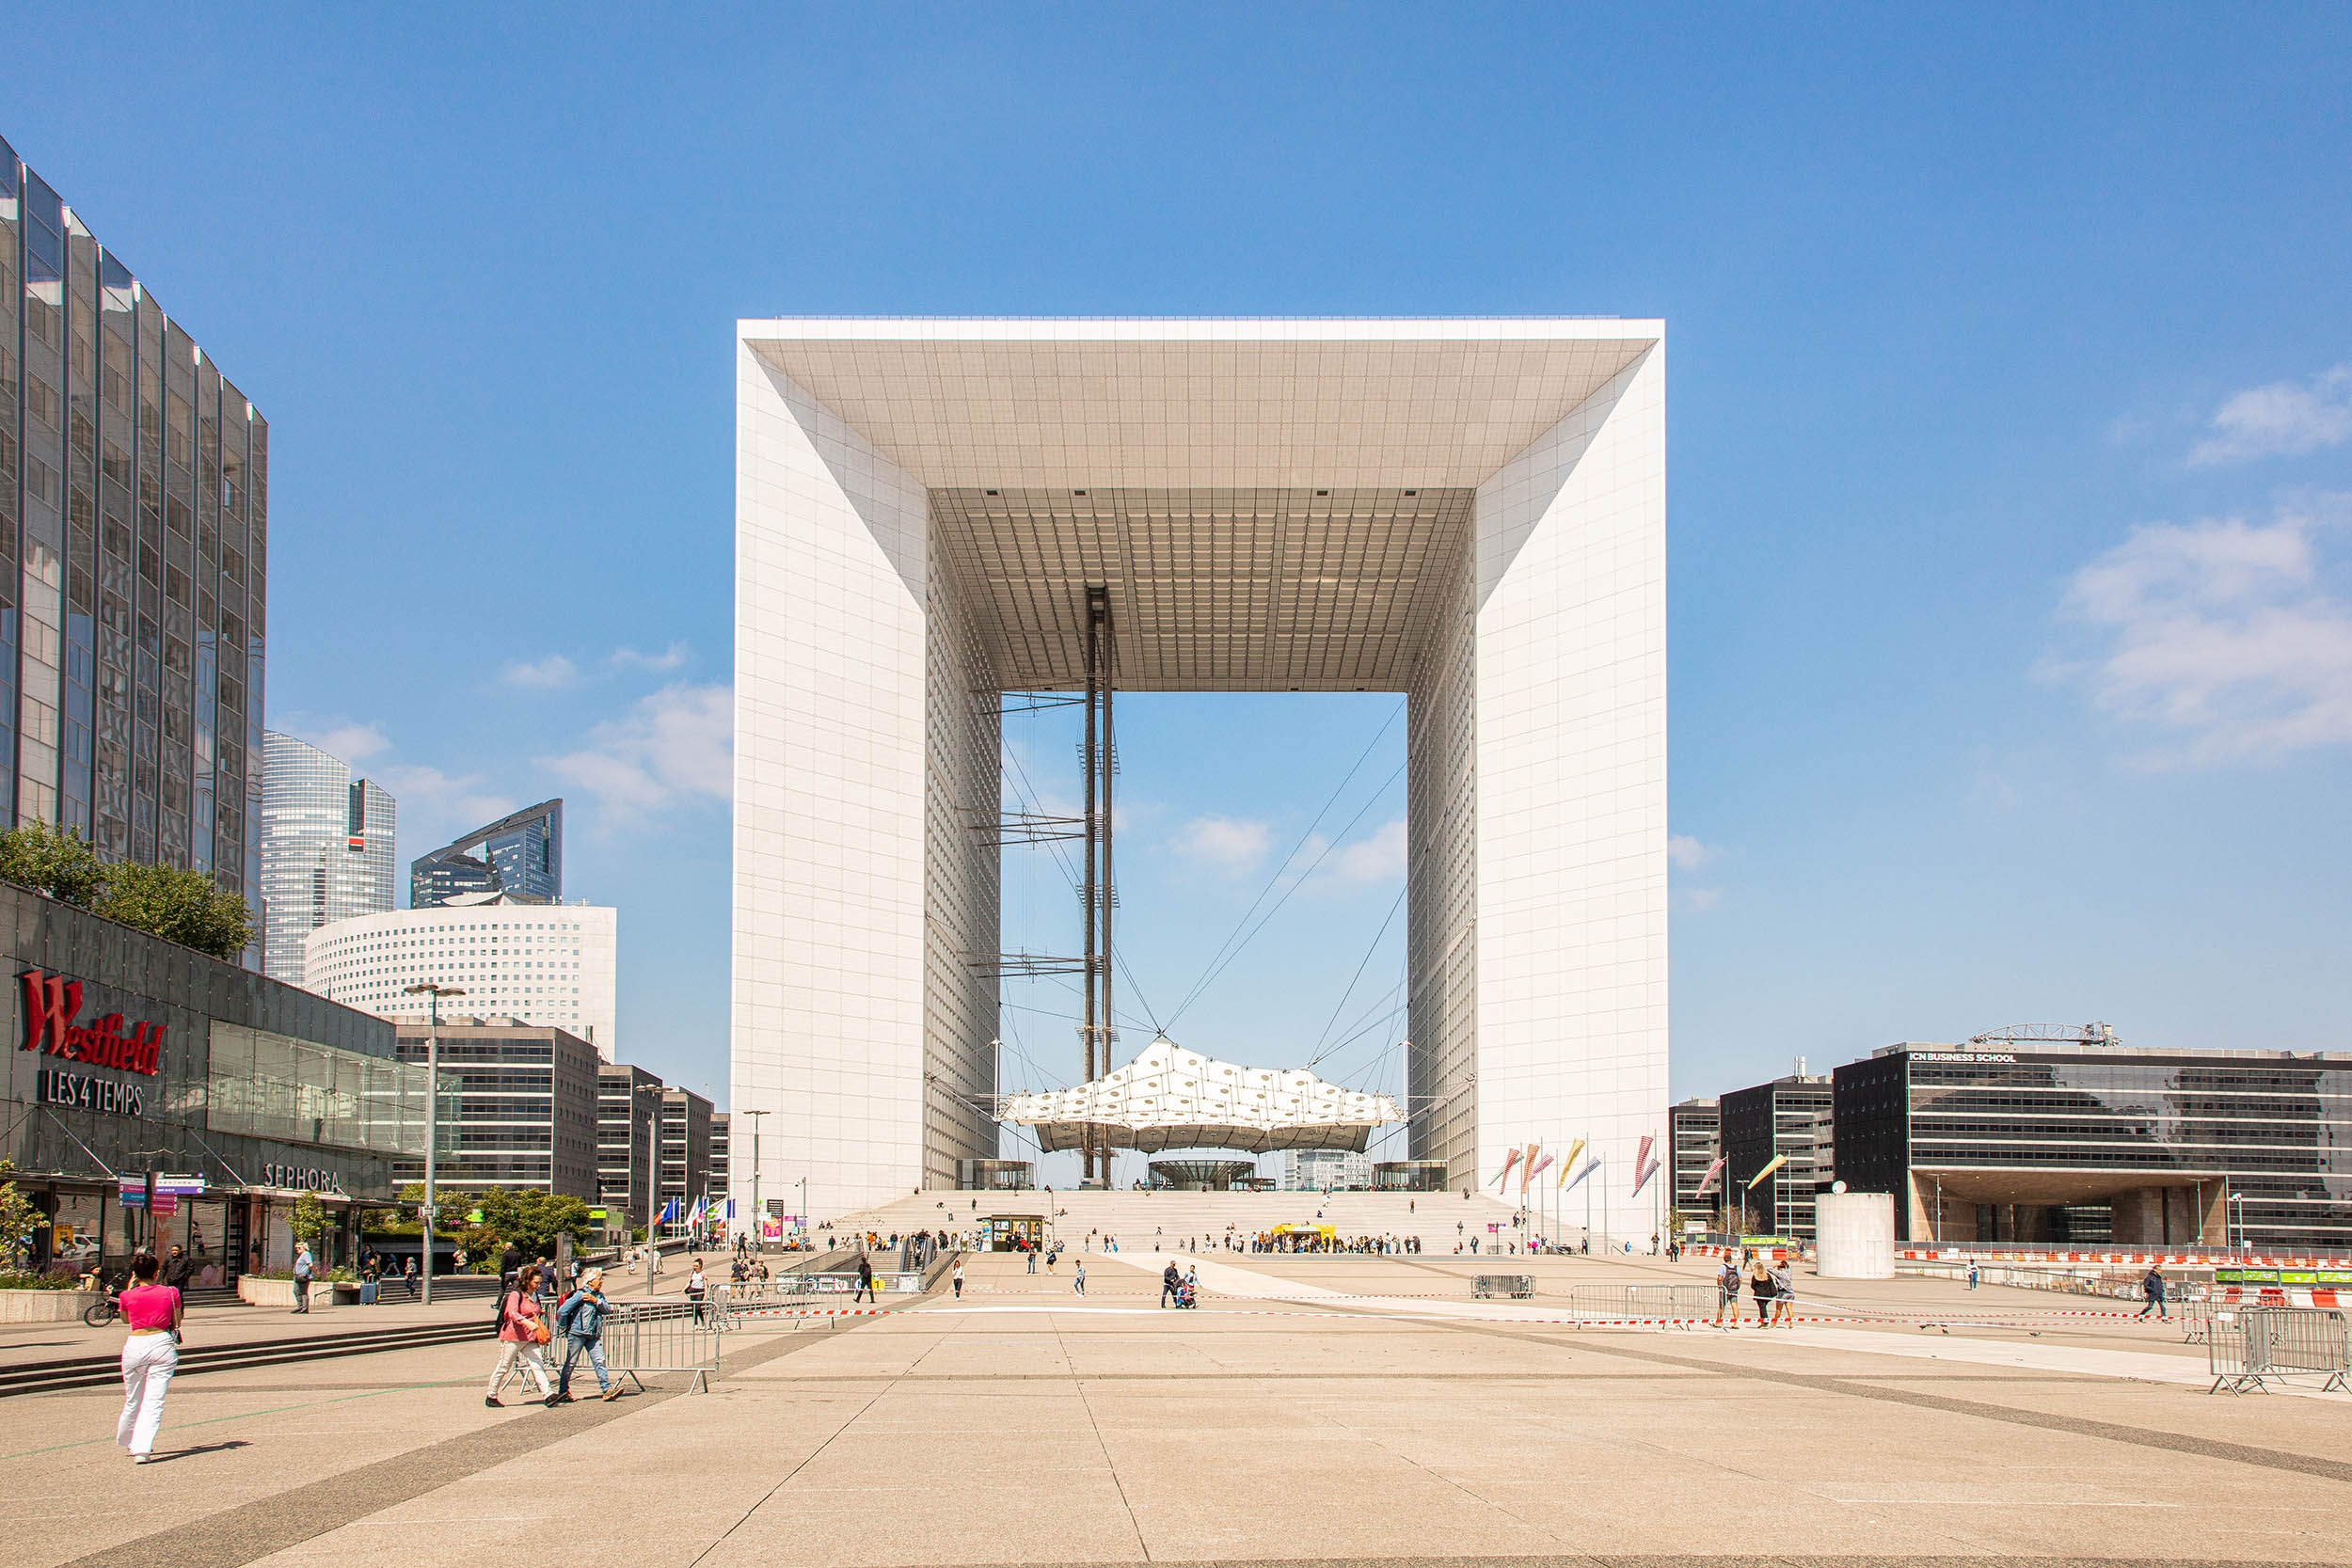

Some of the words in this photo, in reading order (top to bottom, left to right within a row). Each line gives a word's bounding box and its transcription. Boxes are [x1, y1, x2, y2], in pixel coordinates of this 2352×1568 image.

[21, 970, 168, 1076] Westfield
[1909, 1053, 1927, 1061] ICN
[1928, 1053, 1975, 1062] BUSINESS
[1976, 1053, 2017, 1063] SCHOOL
[47, 1069, 76, 1105] LES
[79, 1076, 90, 1107] 4
[94, 1078, 143, 1116] TEMPS
[264, 1163, 339, 1192] SEPHORA
